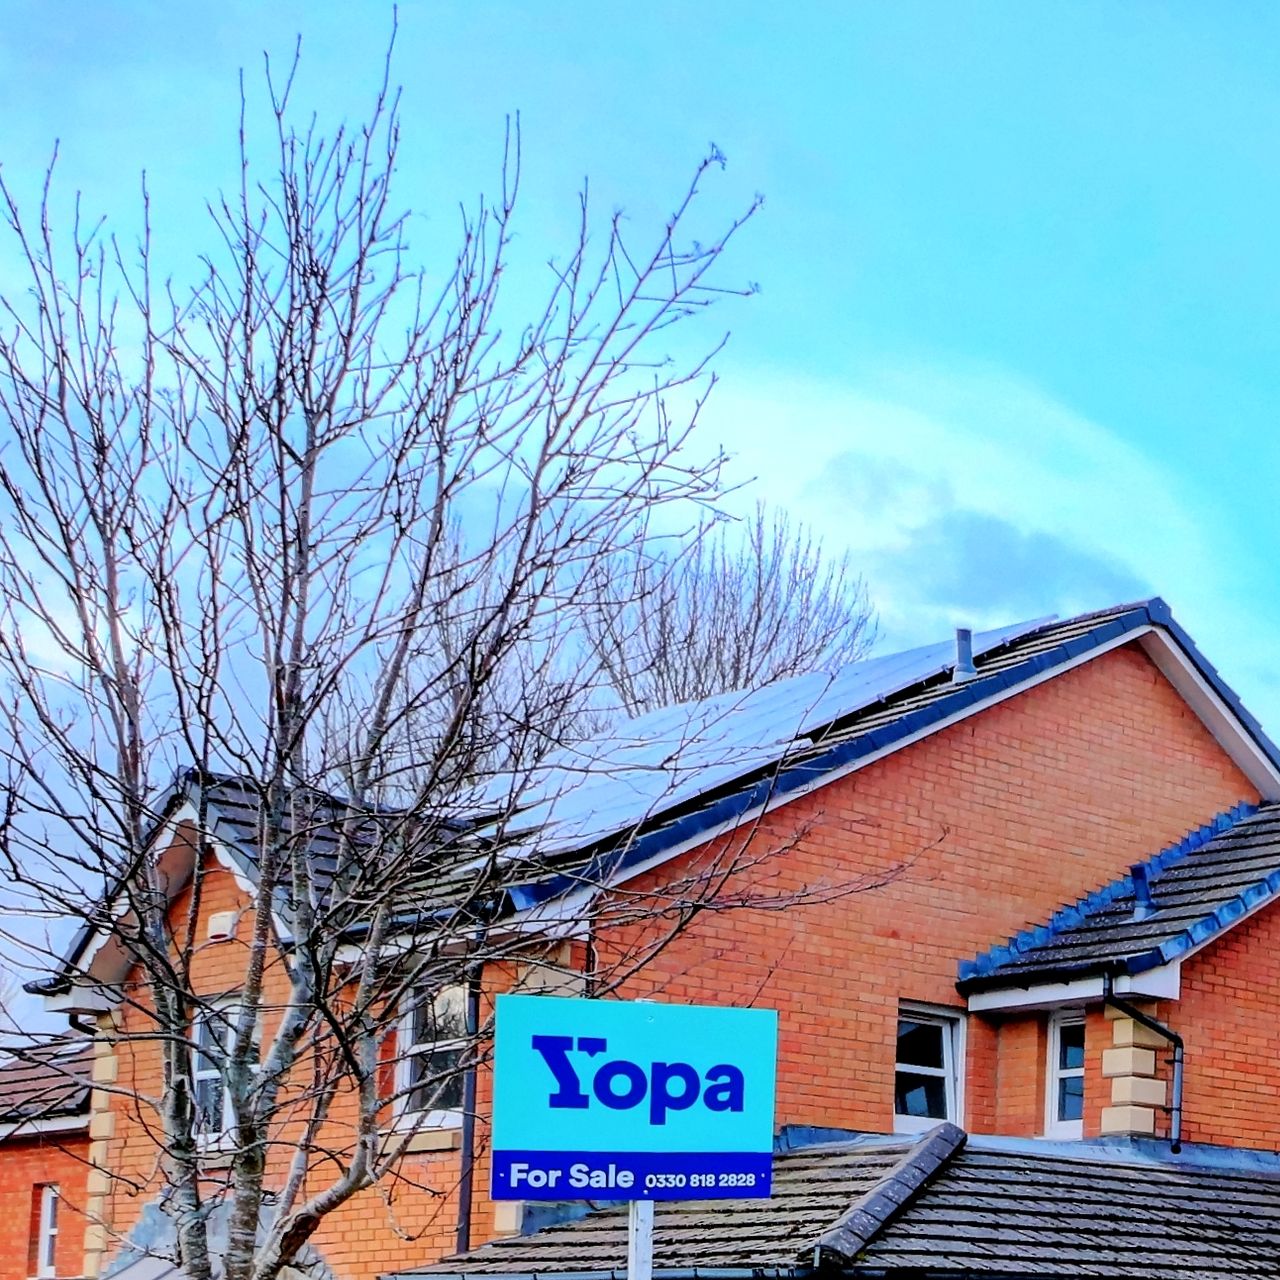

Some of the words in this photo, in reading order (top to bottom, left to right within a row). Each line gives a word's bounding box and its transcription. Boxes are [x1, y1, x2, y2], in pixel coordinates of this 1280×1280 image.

[531, 1034, 745, 1126] Yopa
[510, 1163, 562, 1188] For
[568, 1163, 635, 1188] Sale
[645, 1174, 687, 1188] 0330
[689, 1173, 716, 1187] 818
[718, 1173, 756, 1187] 2828
